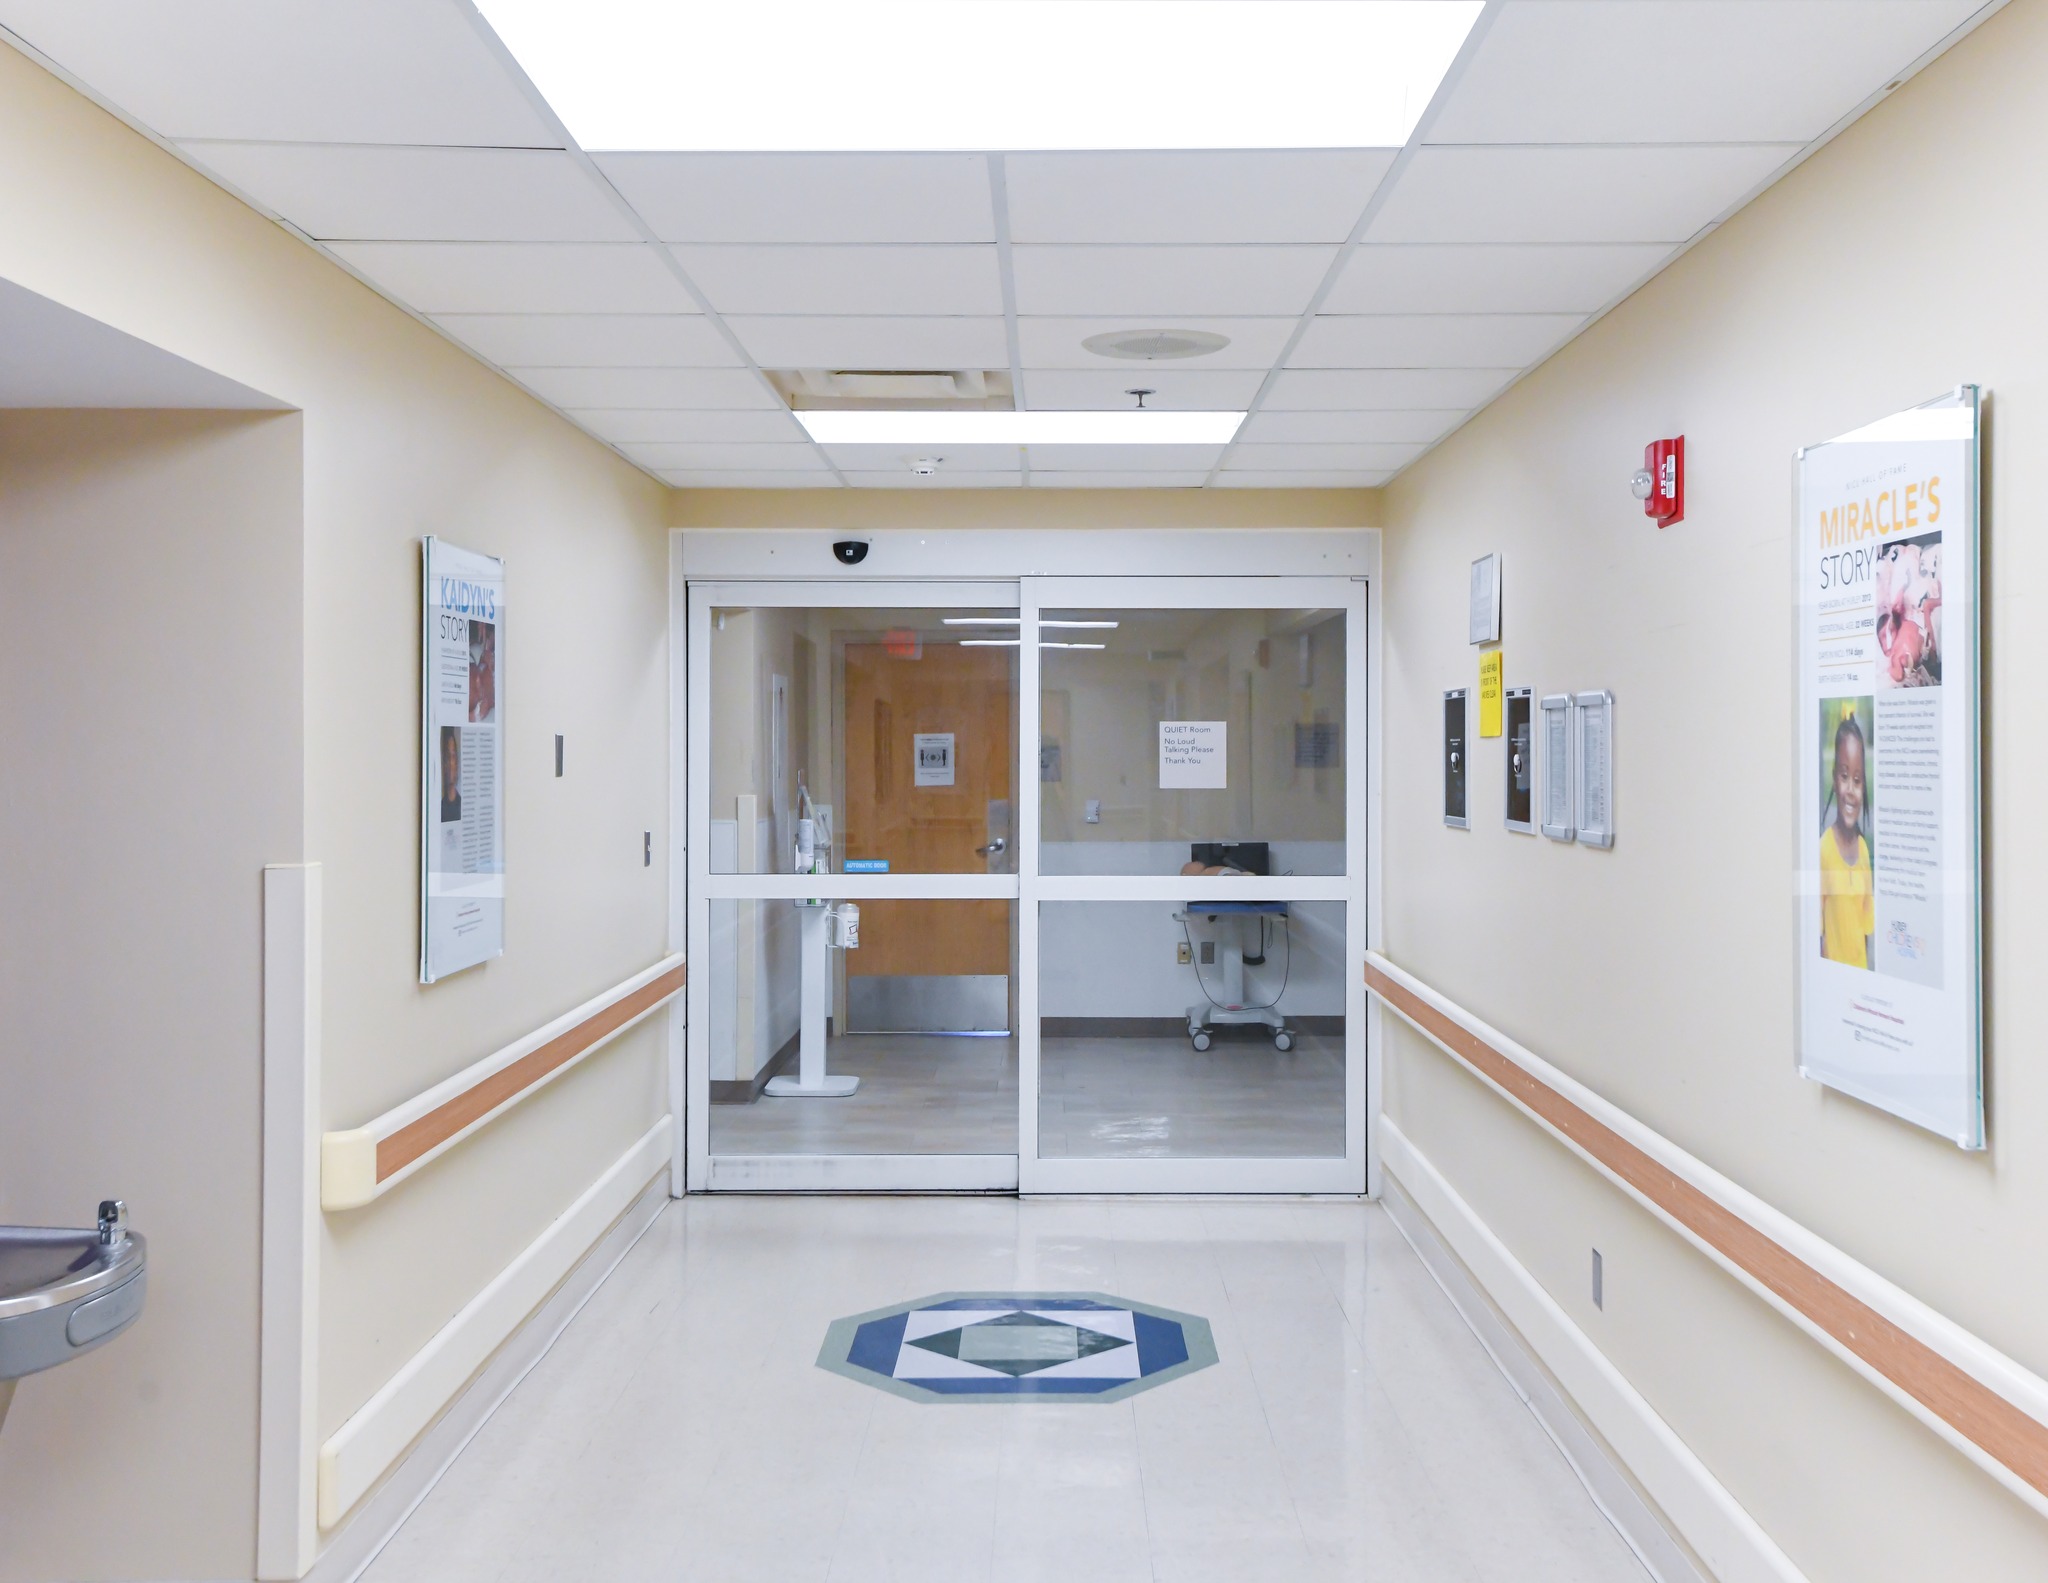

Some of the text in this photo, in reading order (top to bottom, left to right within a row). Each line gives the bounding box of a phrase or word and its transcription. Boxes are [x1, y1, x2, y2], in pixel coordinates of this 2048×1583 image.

[1889, 463, 1908, 475] FAME
[1820, 476, 1941, 549] MIRACLE'S
[1820, 546, 1875, 590] STORY
[441, 576, 495, 620] KAIDYN'S
[440, 614, 469, 642] STORY
[1164, 746, 1190, 755] Talking
